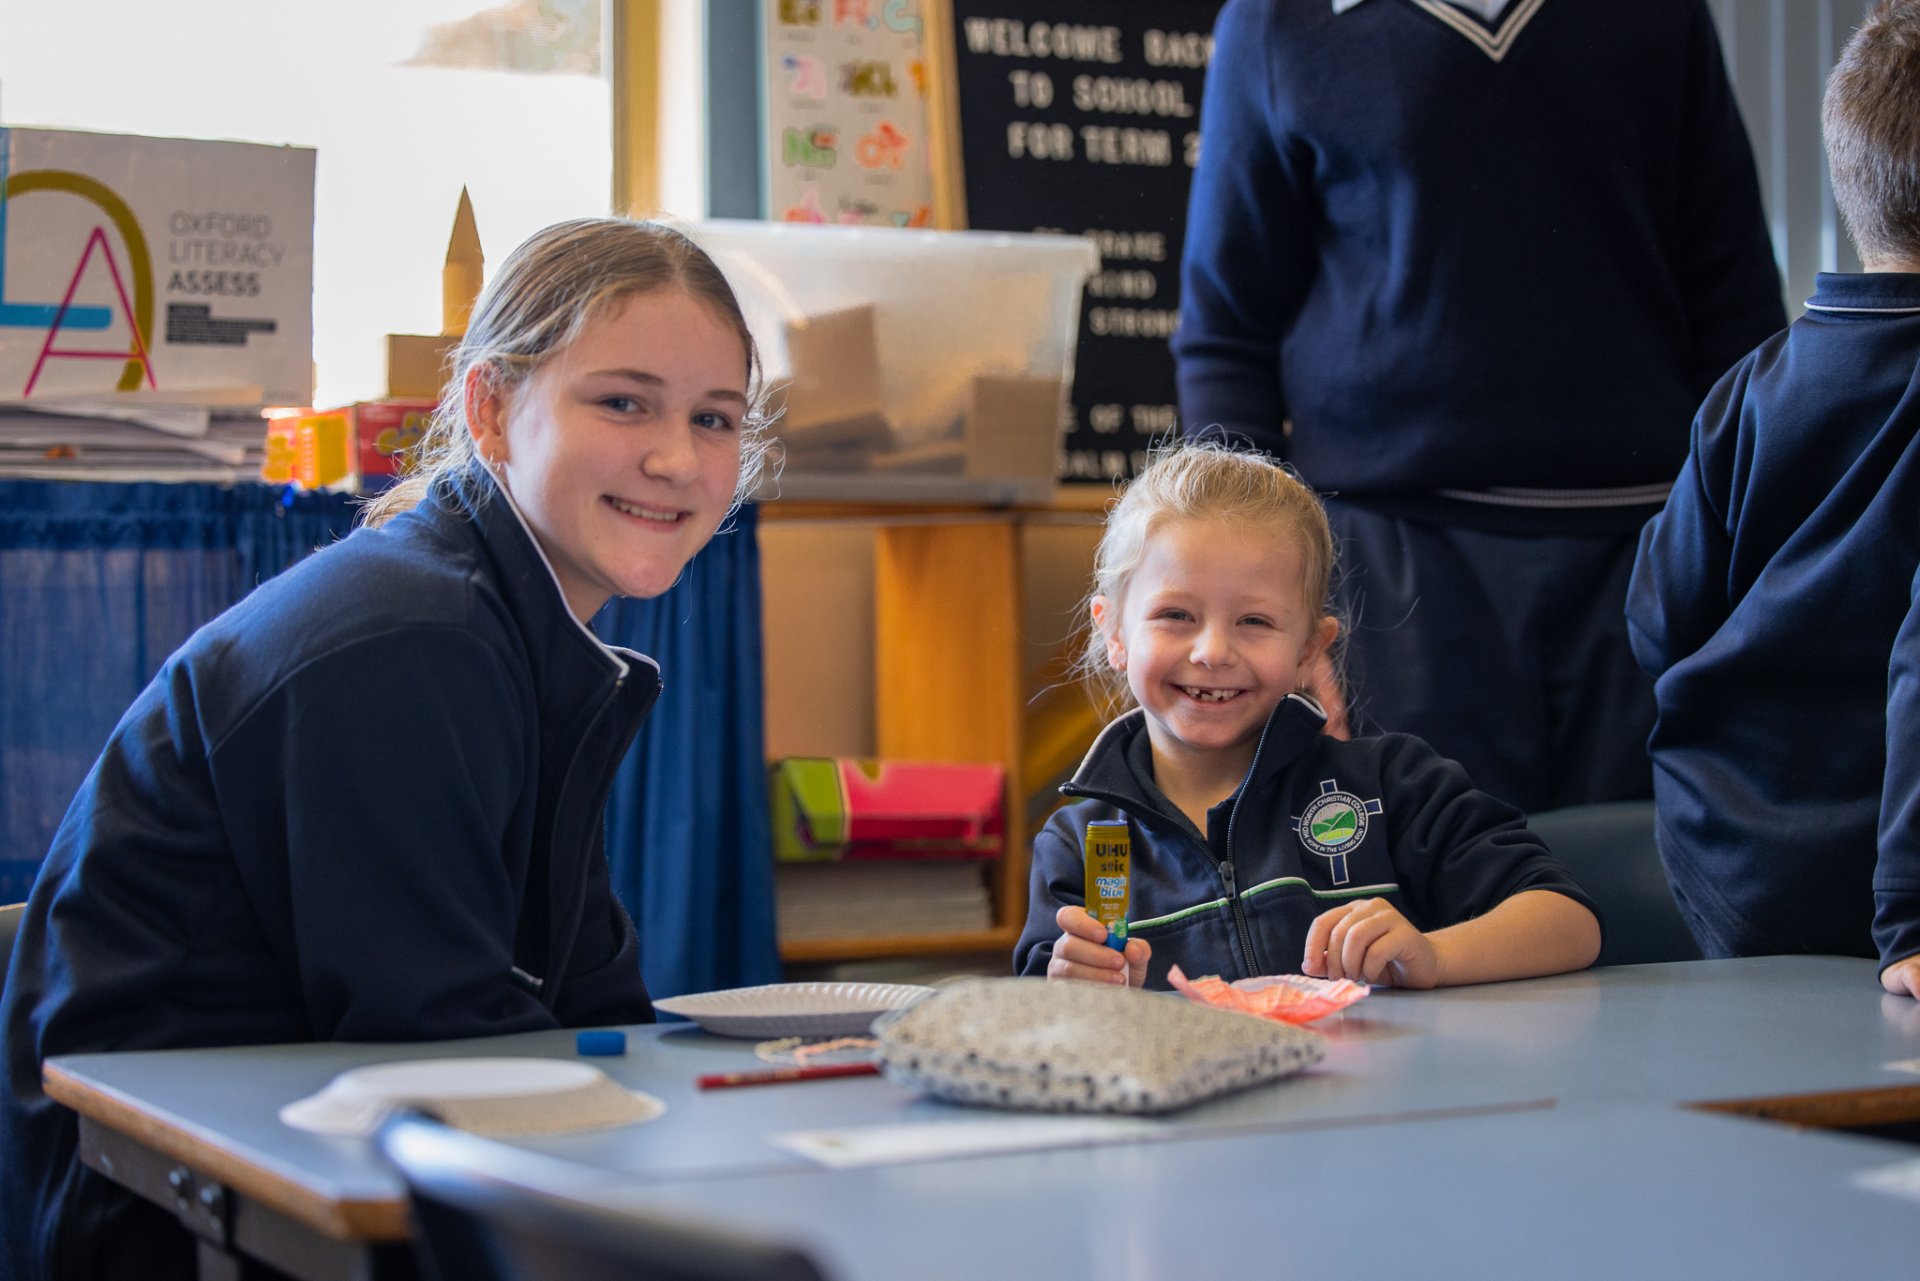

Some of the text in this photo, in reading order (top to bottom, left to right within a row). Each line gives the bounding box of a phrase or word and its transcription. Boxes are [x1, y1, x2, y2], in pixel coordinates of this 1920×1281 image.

[965, 17, 1123, 64] WELCOME
[1009, 70, 1194, 117] TO SCHOOL
[1007, 122, 1074, 160] FOR
[1081, 126, 1172, 166] TERM
[169, 211, 272, 240] OXFORD
[169, 239, 286, 268] LITERACY
[168, 270, 261, 297] ASSESS
[1303, 805, 1318, 826] NORTH
[1317, 795, 1352, 806] CHRISTIAN
[1351, 800, 1365, 826] COLLEGE
[1096, 843, 1128, 857] UHU
[1100, 886, 1125, 898] blue
